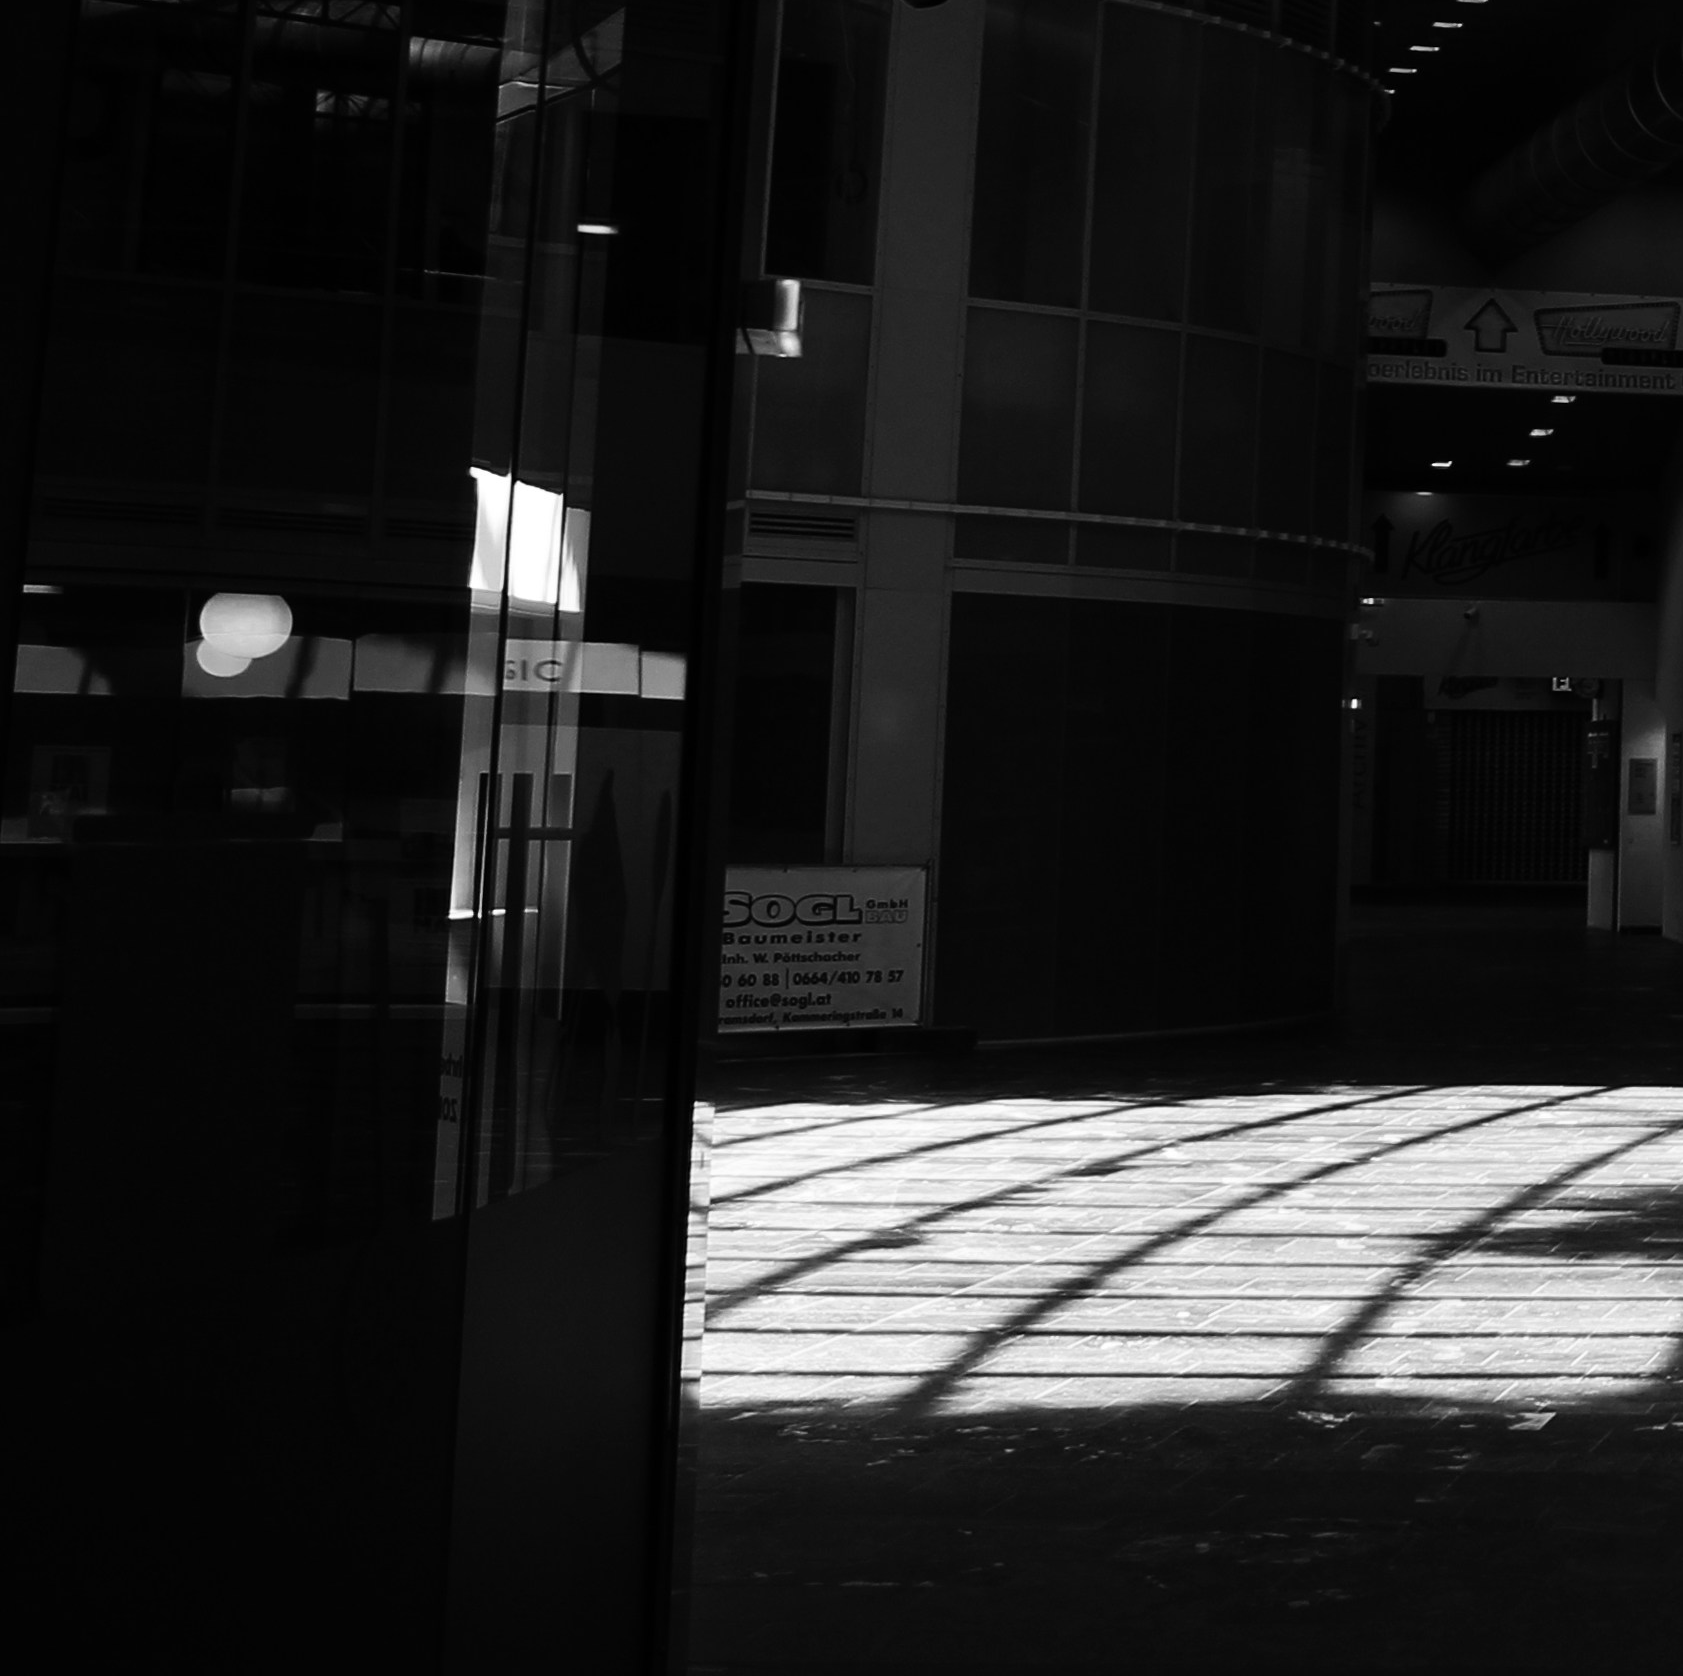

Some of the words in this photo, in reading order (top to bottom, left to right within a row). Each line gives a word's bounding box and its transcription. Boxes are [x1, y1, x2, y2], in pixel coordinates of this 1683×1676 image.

[1540, 315, 1670, 347] Hollywood
[1476, 363, 1502, 383] im
[1510, 366, 1676, 391] Entertainment
[1400, 511, 1585, 586] Klangfarbe
[722, 890, 862, 928] SOGL
[865, 899, 909, 910] GmbH
[864, 909, 909, 924] BAU
[722, 930, 862, 945] Baumeister
[721, 953, 749, 965] Inh.
[752, 952, 769, 964] W.
[737, 973, 757, 988] 60
[762, 972, 780, 987] 88
[792, 970, 861, 986] 0664/410
[865, 969, 883, 984] 78
[887, 969, 905, 983] 57
[725, 992, 832, 1010] office@sogl.at
